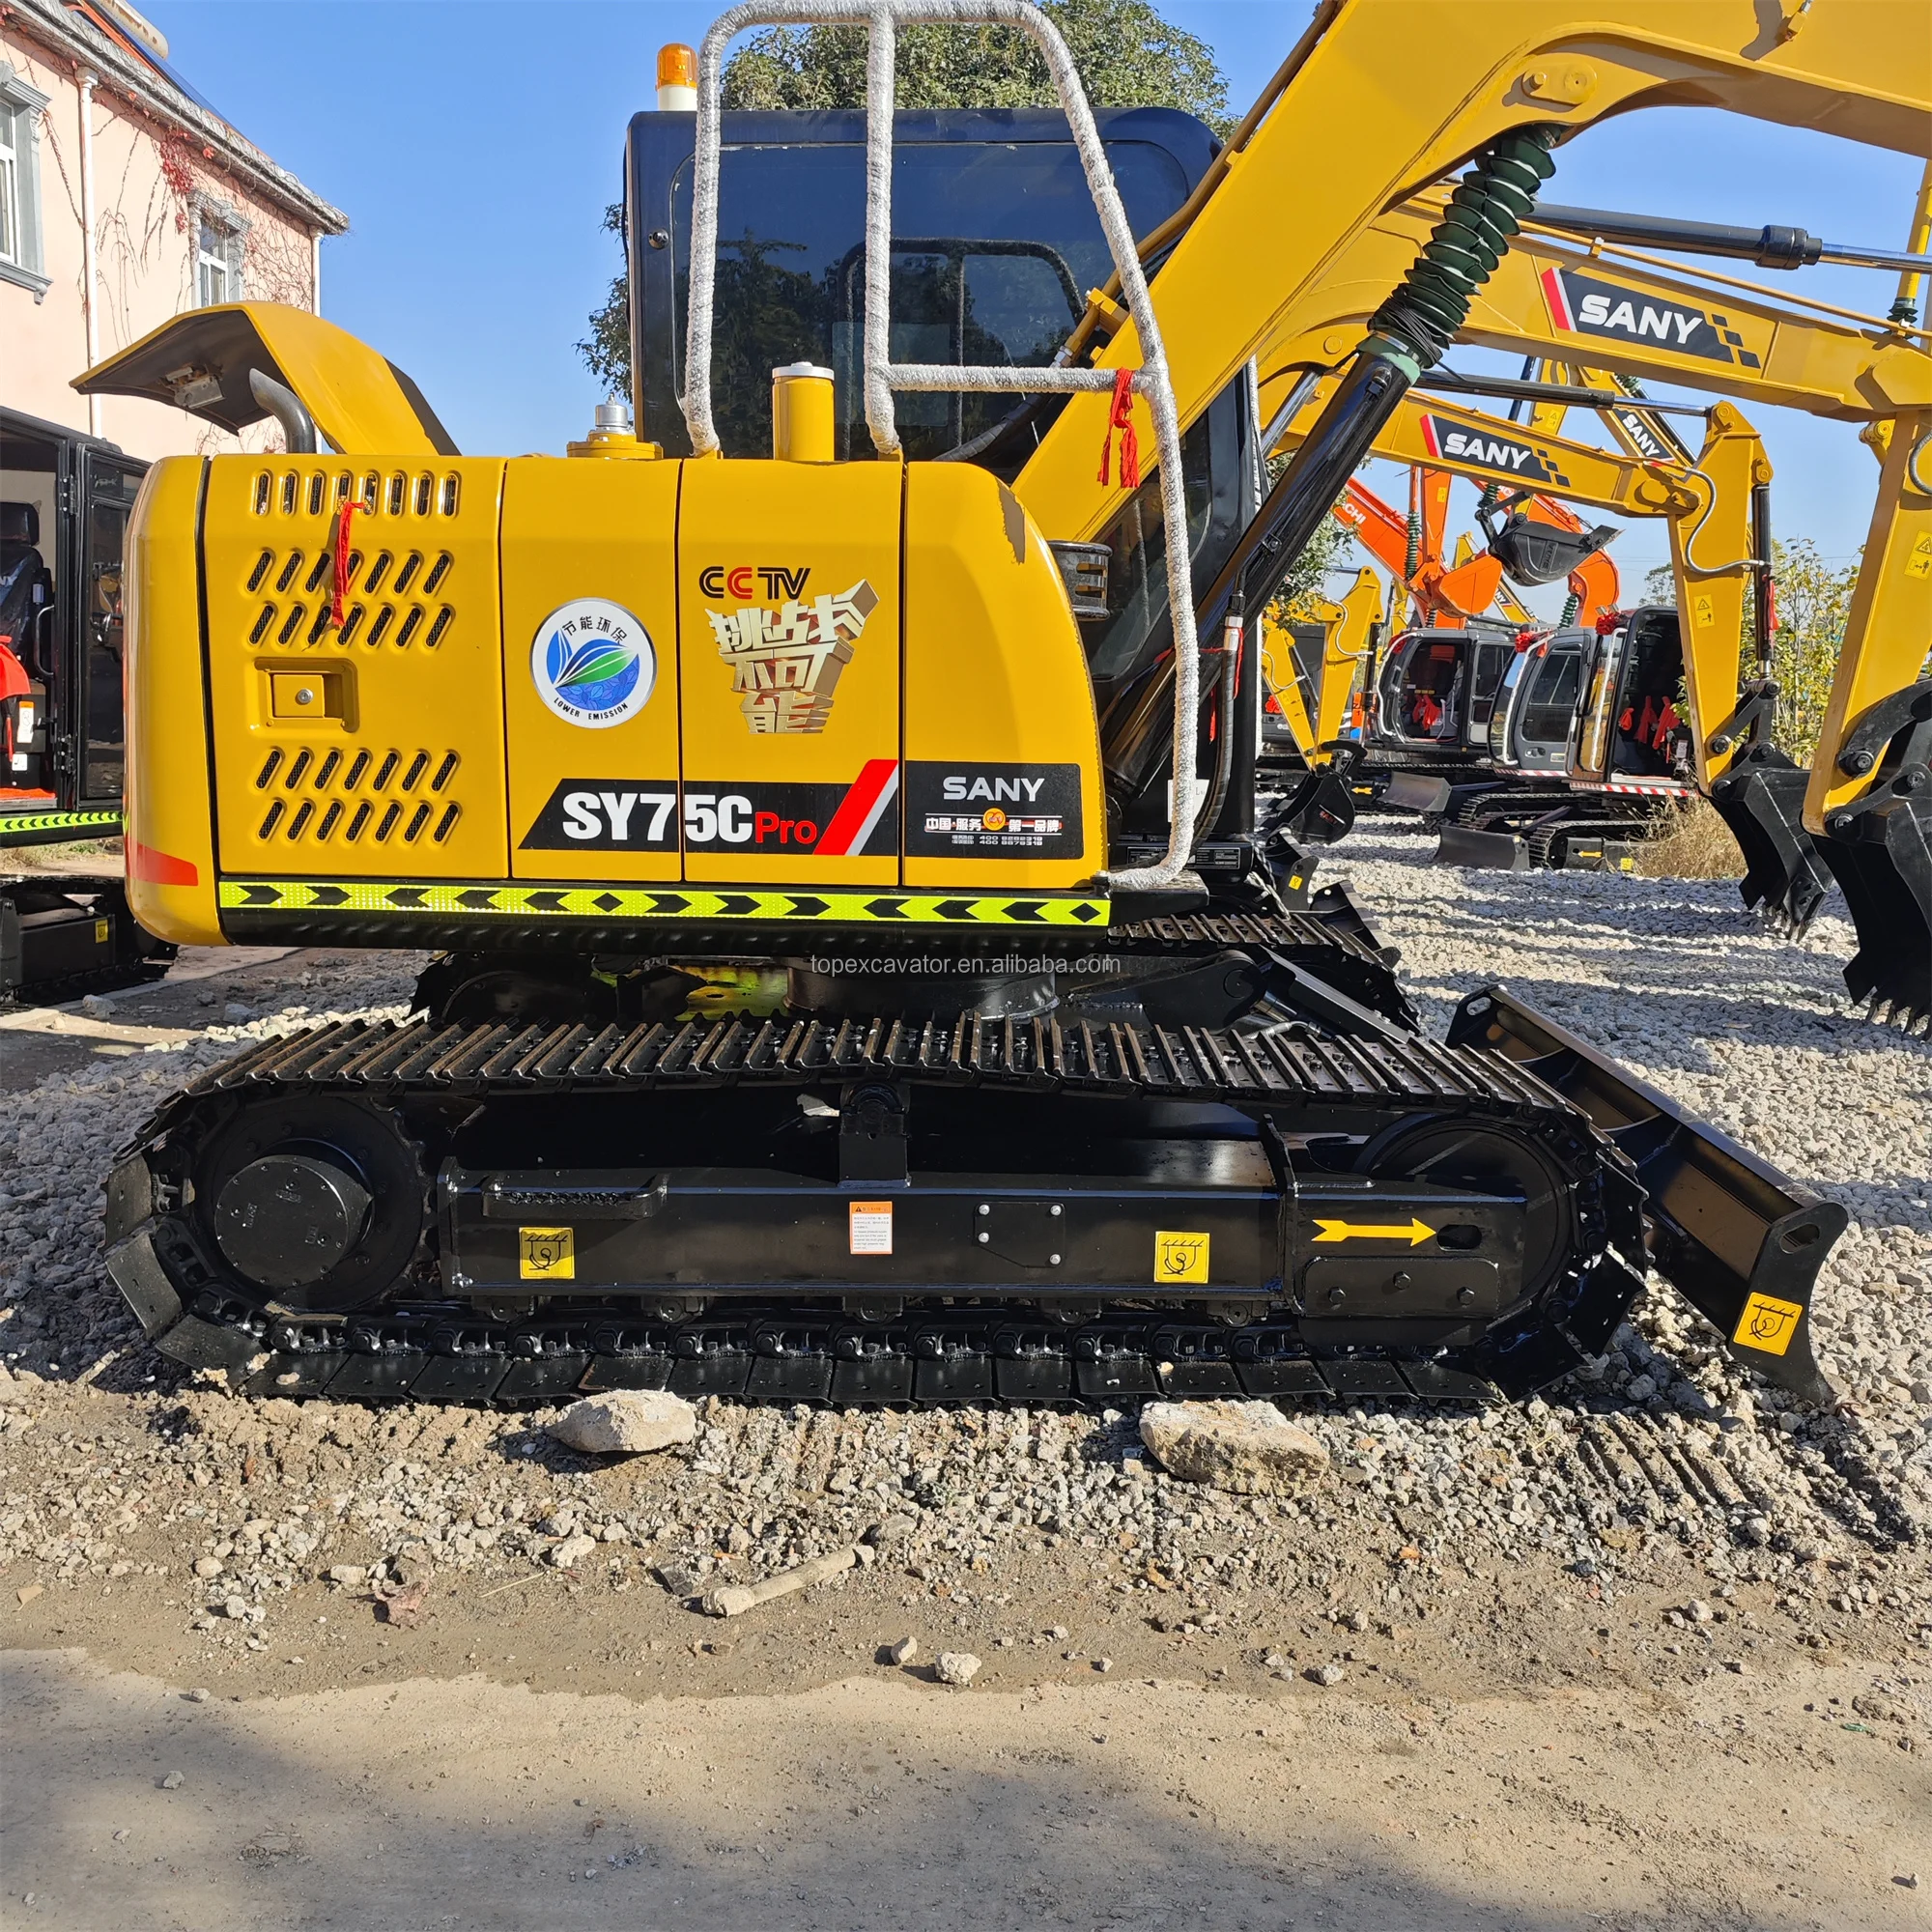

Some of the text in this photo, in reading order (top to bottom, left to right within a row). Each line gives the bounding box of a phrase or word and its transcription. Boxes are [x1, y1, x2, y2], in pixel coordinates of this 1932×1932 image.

[1578, 294, 1704, 345] SANY
[1443, 433, 1533, 470] SANY
[1622, 413, 1661, 457] SANY
[698, 566, 811, 600] CCTV
[561, 615, 628, 645] 节能环保
[704, 578, 880, 655] 挑战
[720, 636, 854, 696] 不可
[554, 696, 629, 721] LOWER EMISSION
[738, 690, 835, 734] 能
[943, 776, 1044, 802] SANY
[562, 791, 817, 844] SY75C Pro
[1008, 819, 1061, 833] 第一品牌
